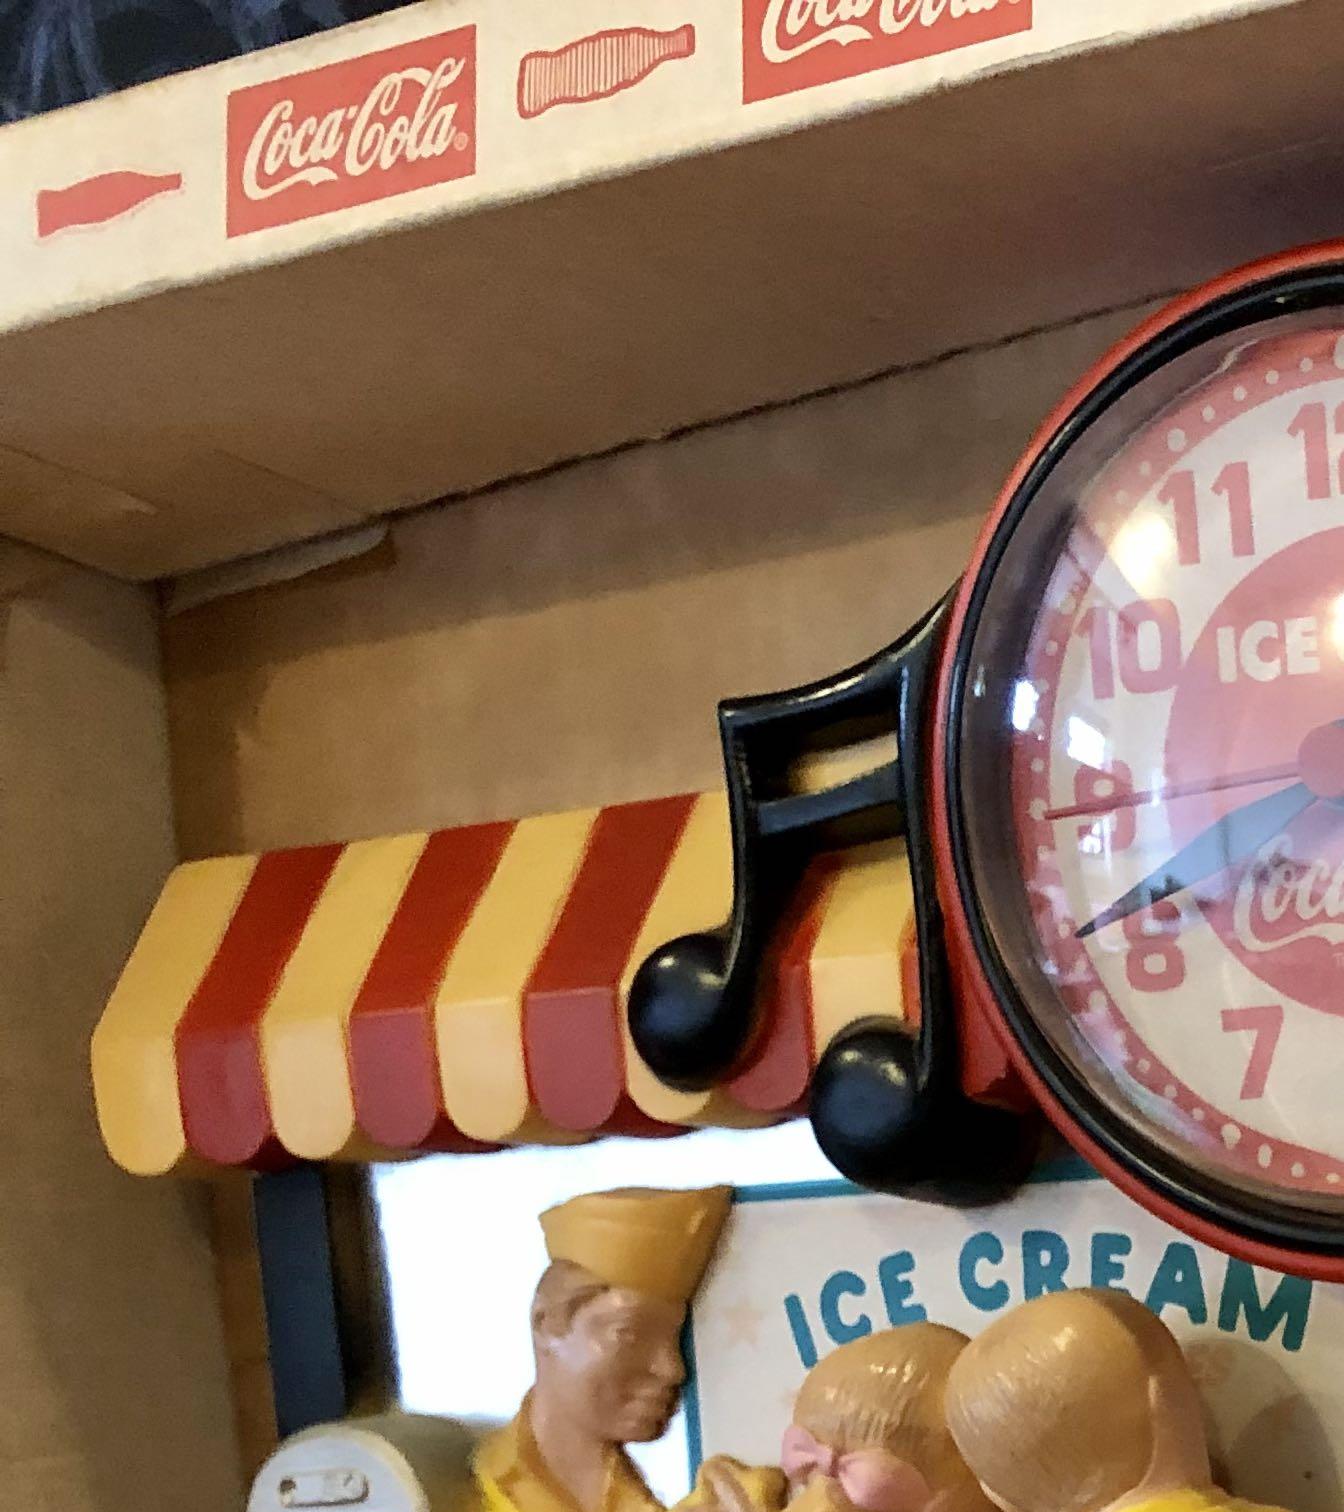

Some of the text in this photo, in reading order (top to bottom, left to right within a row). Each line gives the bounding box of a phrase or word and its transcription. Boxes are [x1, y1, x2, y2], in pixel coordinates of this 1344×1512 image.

[1158, 461, 1256, 566] 11
[1076, 597, 1182, 700] 10
[1216, 616, 1321, 684] ICE
[1074, 759, 1137, 851] 9
[1122, 894, 1186, 992] 8
[1221, 1005, 1285, 1101] 7
[783, 1230, 1315, 1370] ICE CREAM
